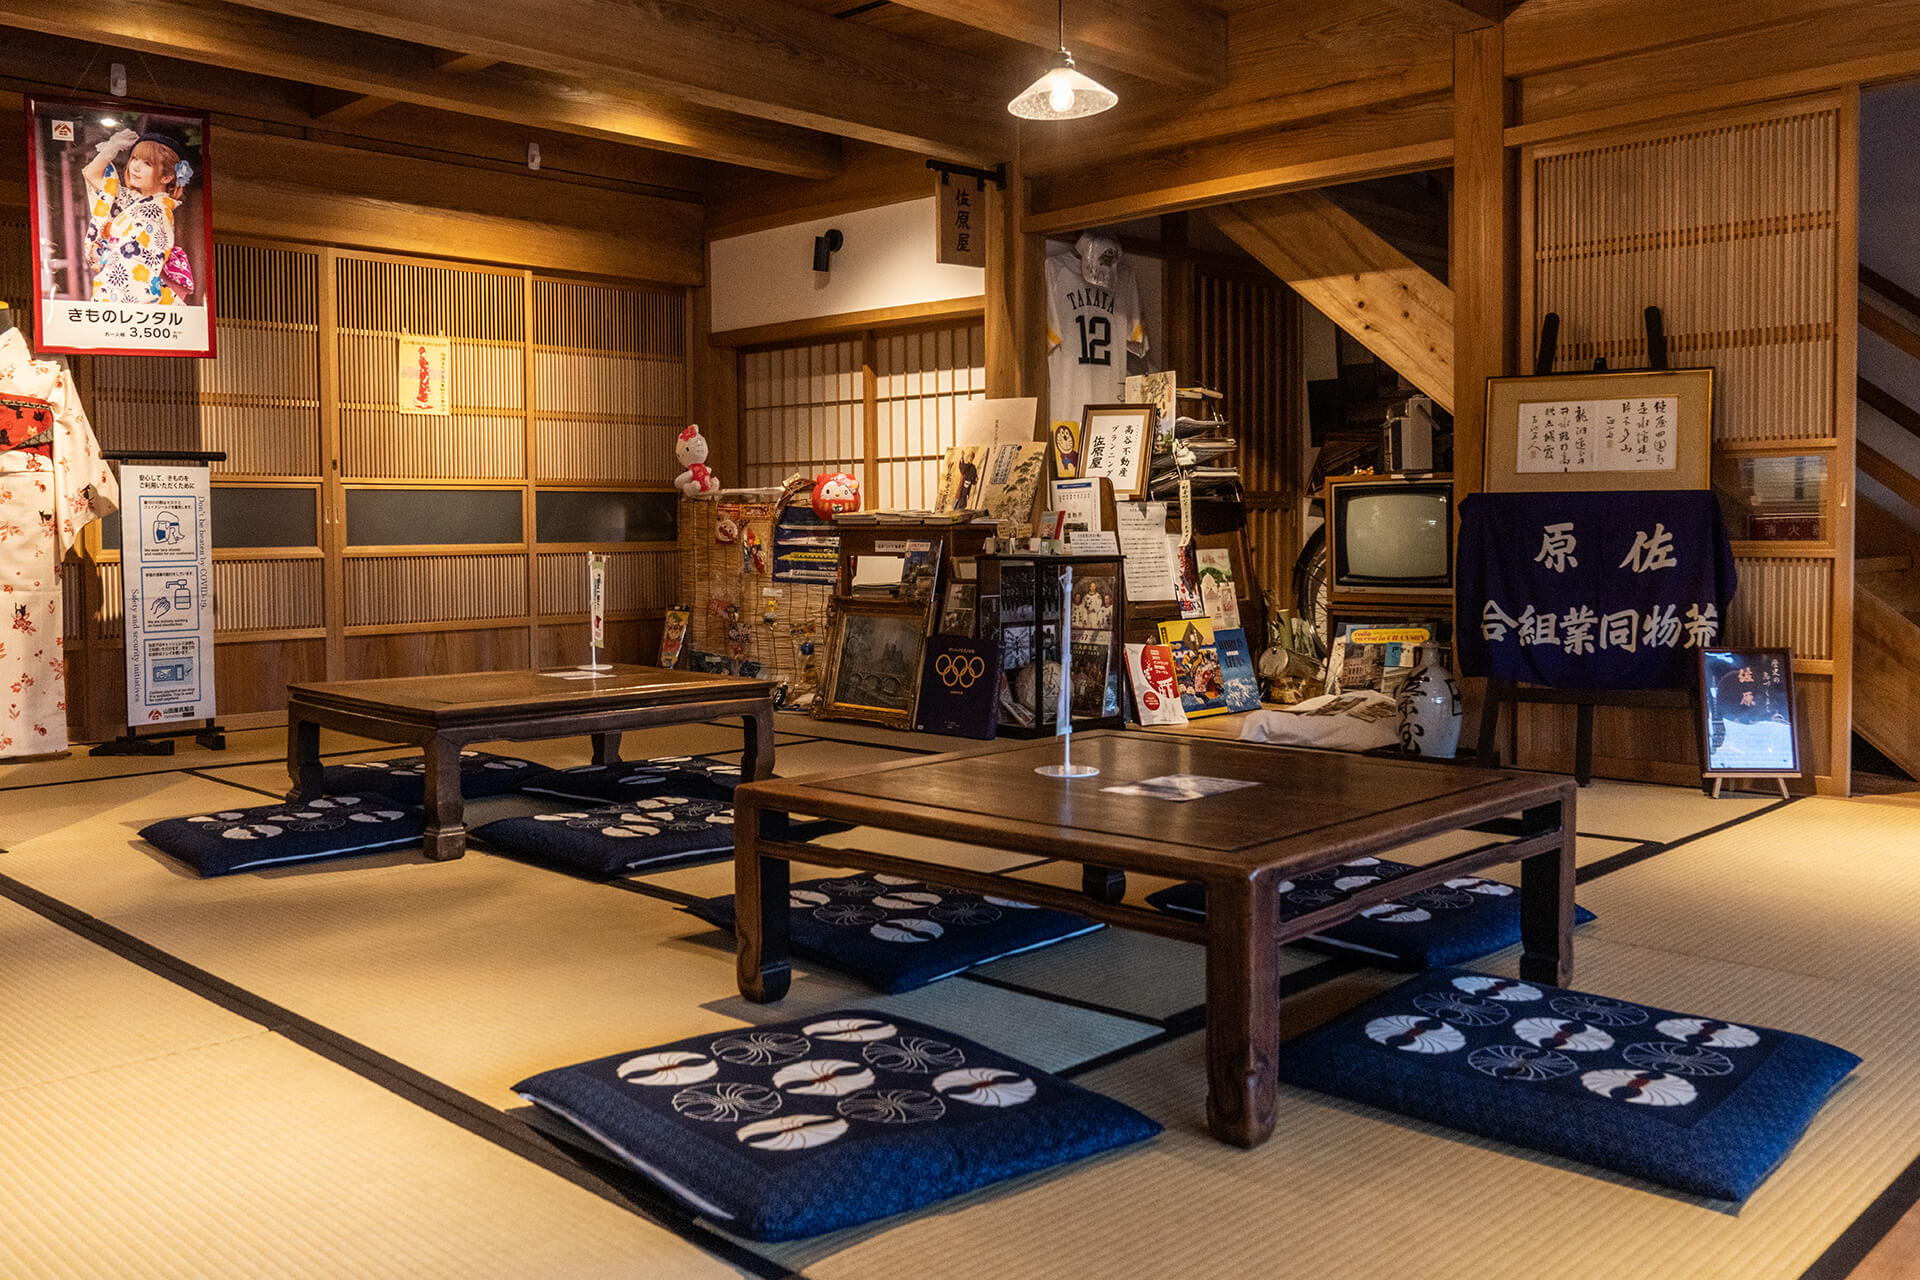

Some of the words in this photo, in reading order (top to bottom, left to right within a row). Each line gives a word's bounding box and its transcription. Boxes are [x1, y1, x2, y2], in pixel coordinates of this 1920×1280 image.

[956, 188, 970, 253] 佐原屋
[1067, 288, 1114, 315] TAKAYA
[68, 308, 183, 327] きものレンタル
[1076, 315, 1111, 366] 12
[1088, 435, 1106, 470] 佐原屋
[1119, 425, 1134, 478] 高谷不動産
[198, 496, 206, 517] Don't
[1534, 522, 1678, 574] 佐原
[130, 588, 140, 611] Safety
[132, 614, 140, 629] and
